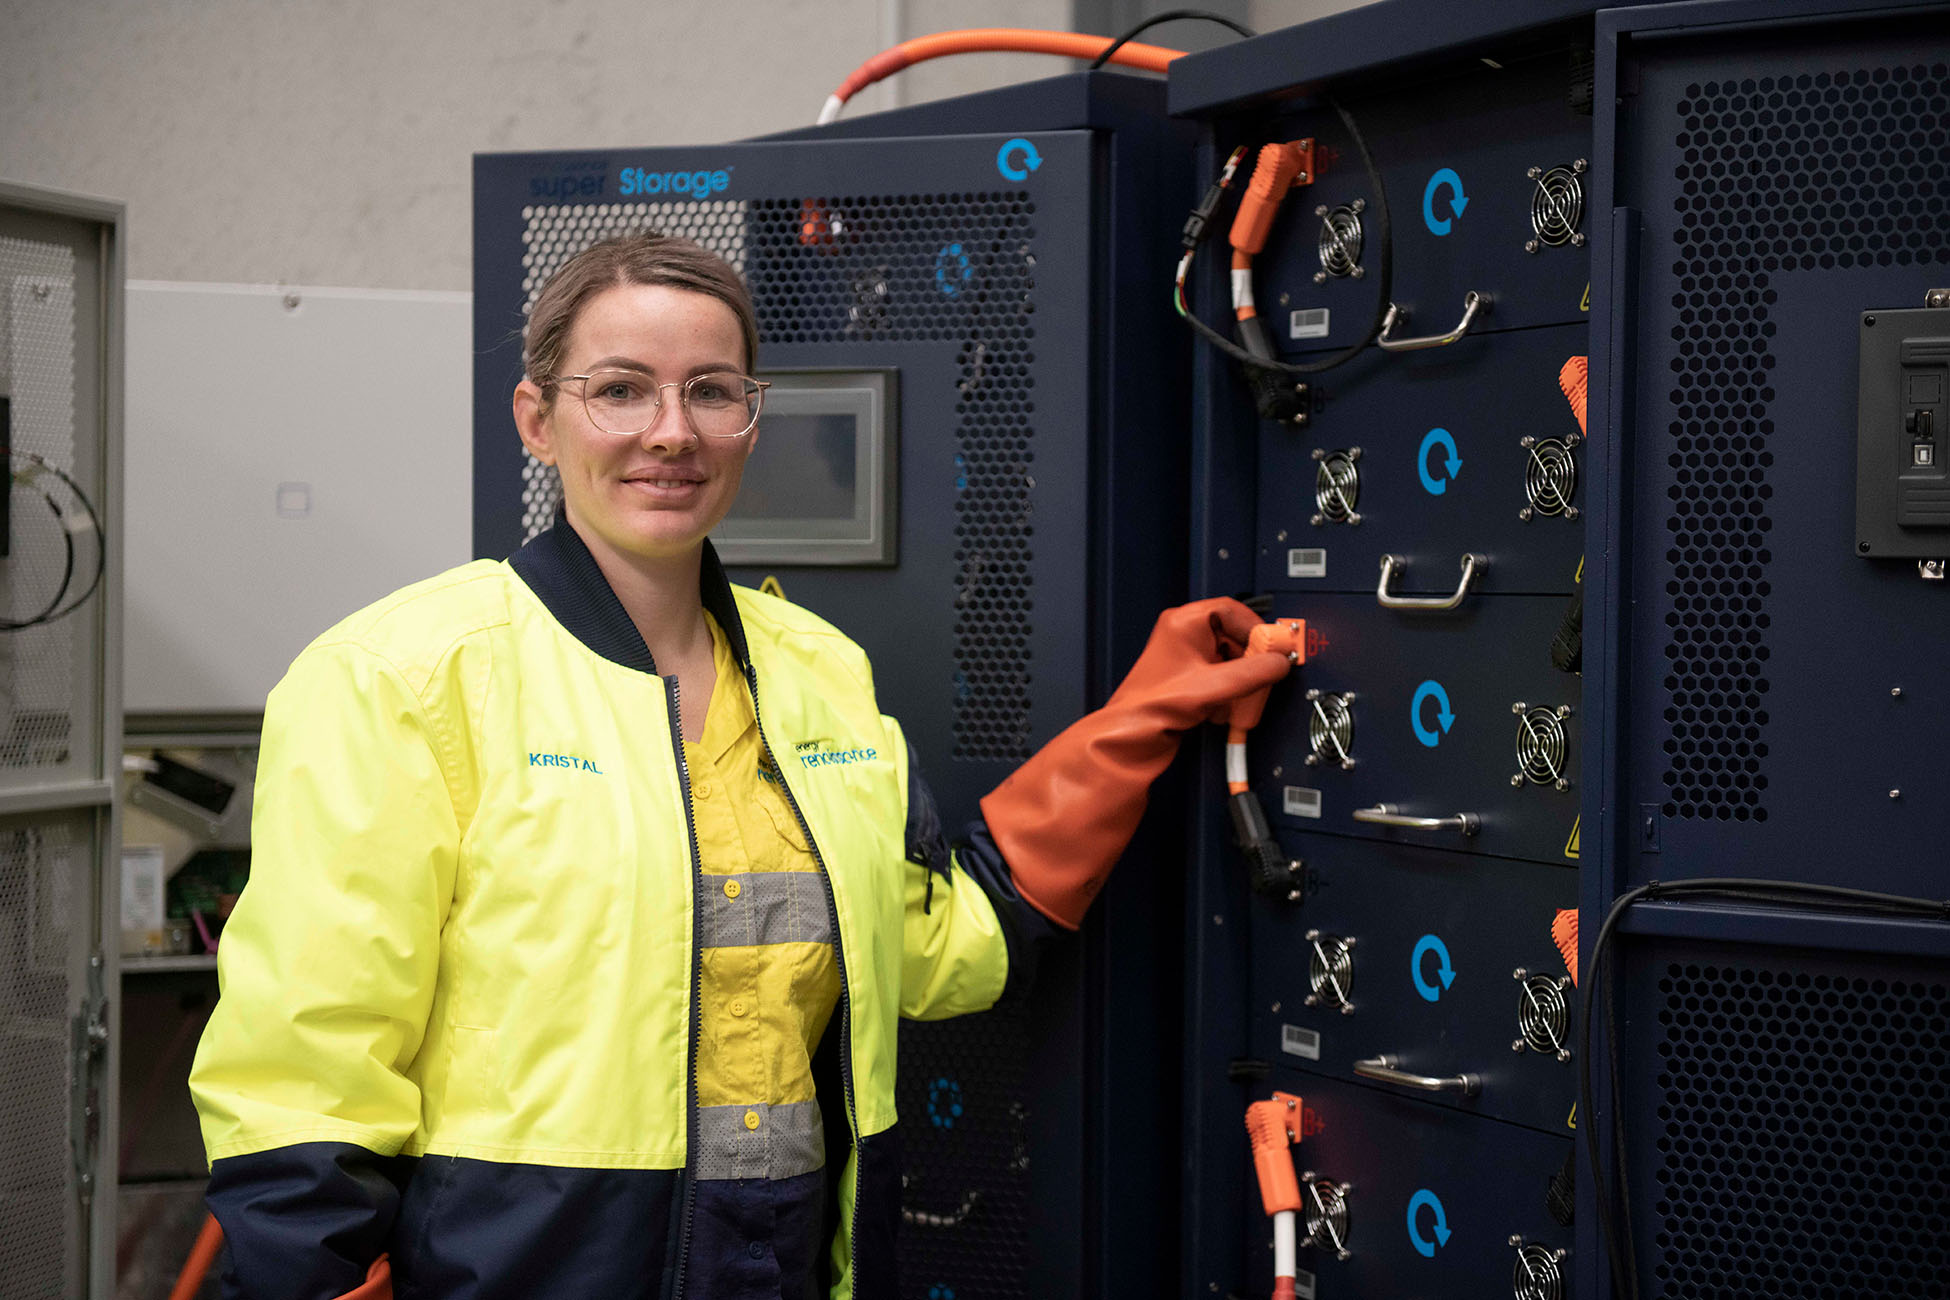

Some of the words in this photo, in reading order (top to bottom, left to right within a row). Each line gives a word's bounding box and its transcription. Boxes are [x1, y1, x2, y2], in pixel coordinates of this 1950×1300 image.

[618, 167, 730, 199] Storage
[1307, 628, 1330, 657] B+
[528, 752, 603, 775] KRISTAL
